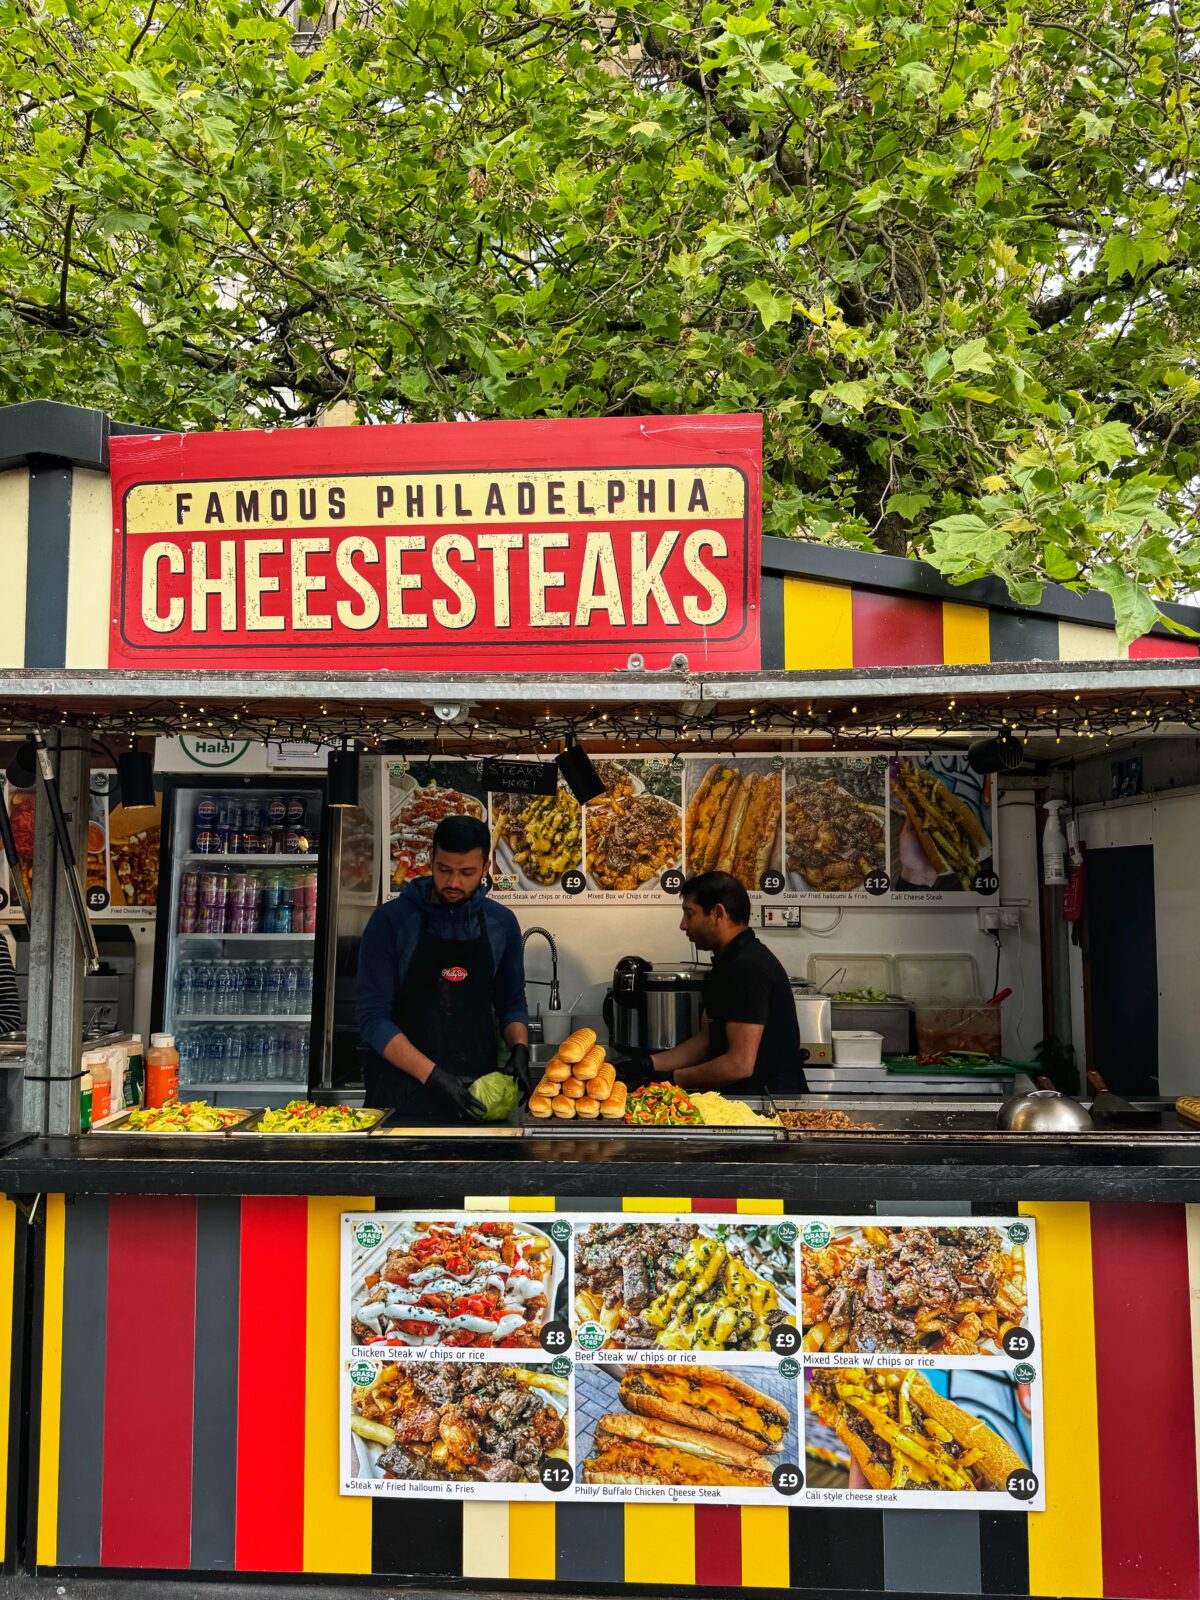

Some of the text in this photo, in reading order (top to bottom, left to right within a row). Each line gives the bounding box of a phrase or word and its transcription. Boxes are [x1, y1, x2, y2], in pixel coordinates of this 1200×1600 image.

[177, 478, 710, 525] FAMOUS PHILADELPHIA
[141, 529, 730, 634] CHEESESTEAKS
[195, 741, 235, 754] Halal
[488, 763, 544, 777] STEAKS
[566, 877, 581, 888] £9
[665, 877, 681, 888] £9
[764, 877, 780, 888] £9
[865, 878, 888, 889] £12
[975, 878, 998, 889] £10
[90, 893, 105, 904] £9
[538, 893, 553, 901] chips
[625, 893, 642, 901] Chips
[357, 1232, 381, 1240] GRASS
[804, 1232, 829, 1240] GRASS
[546, 1331, 566, 1345] £8
[579, 1334, 603, 1342] GRASS
[775, 1333, 796, 1347] £9
[1008, 1336, 1029, 1350] £9
[351, 1347, 485, 1361] Chicken Steak w/ chips or rice
[575, 1351, 697, 1363] Beef Steak w/ chips or rice
[803, 1354, 935, 1367] Mixed Steak w/ chips or rice
[543, 1468, 570, 1482] £12
[778, 1473, 798, 1487] £9
[350, 1480, 475, 1493] Steak w/ Fried halloumi & Fries
[1008, 1478, 1036, 1492] £10
[574, 1486, 721, 1498] Philly/ Buffalo Chicken Cheese Steak
[805, 1491, 898, 1502] Cali style cheese steak
